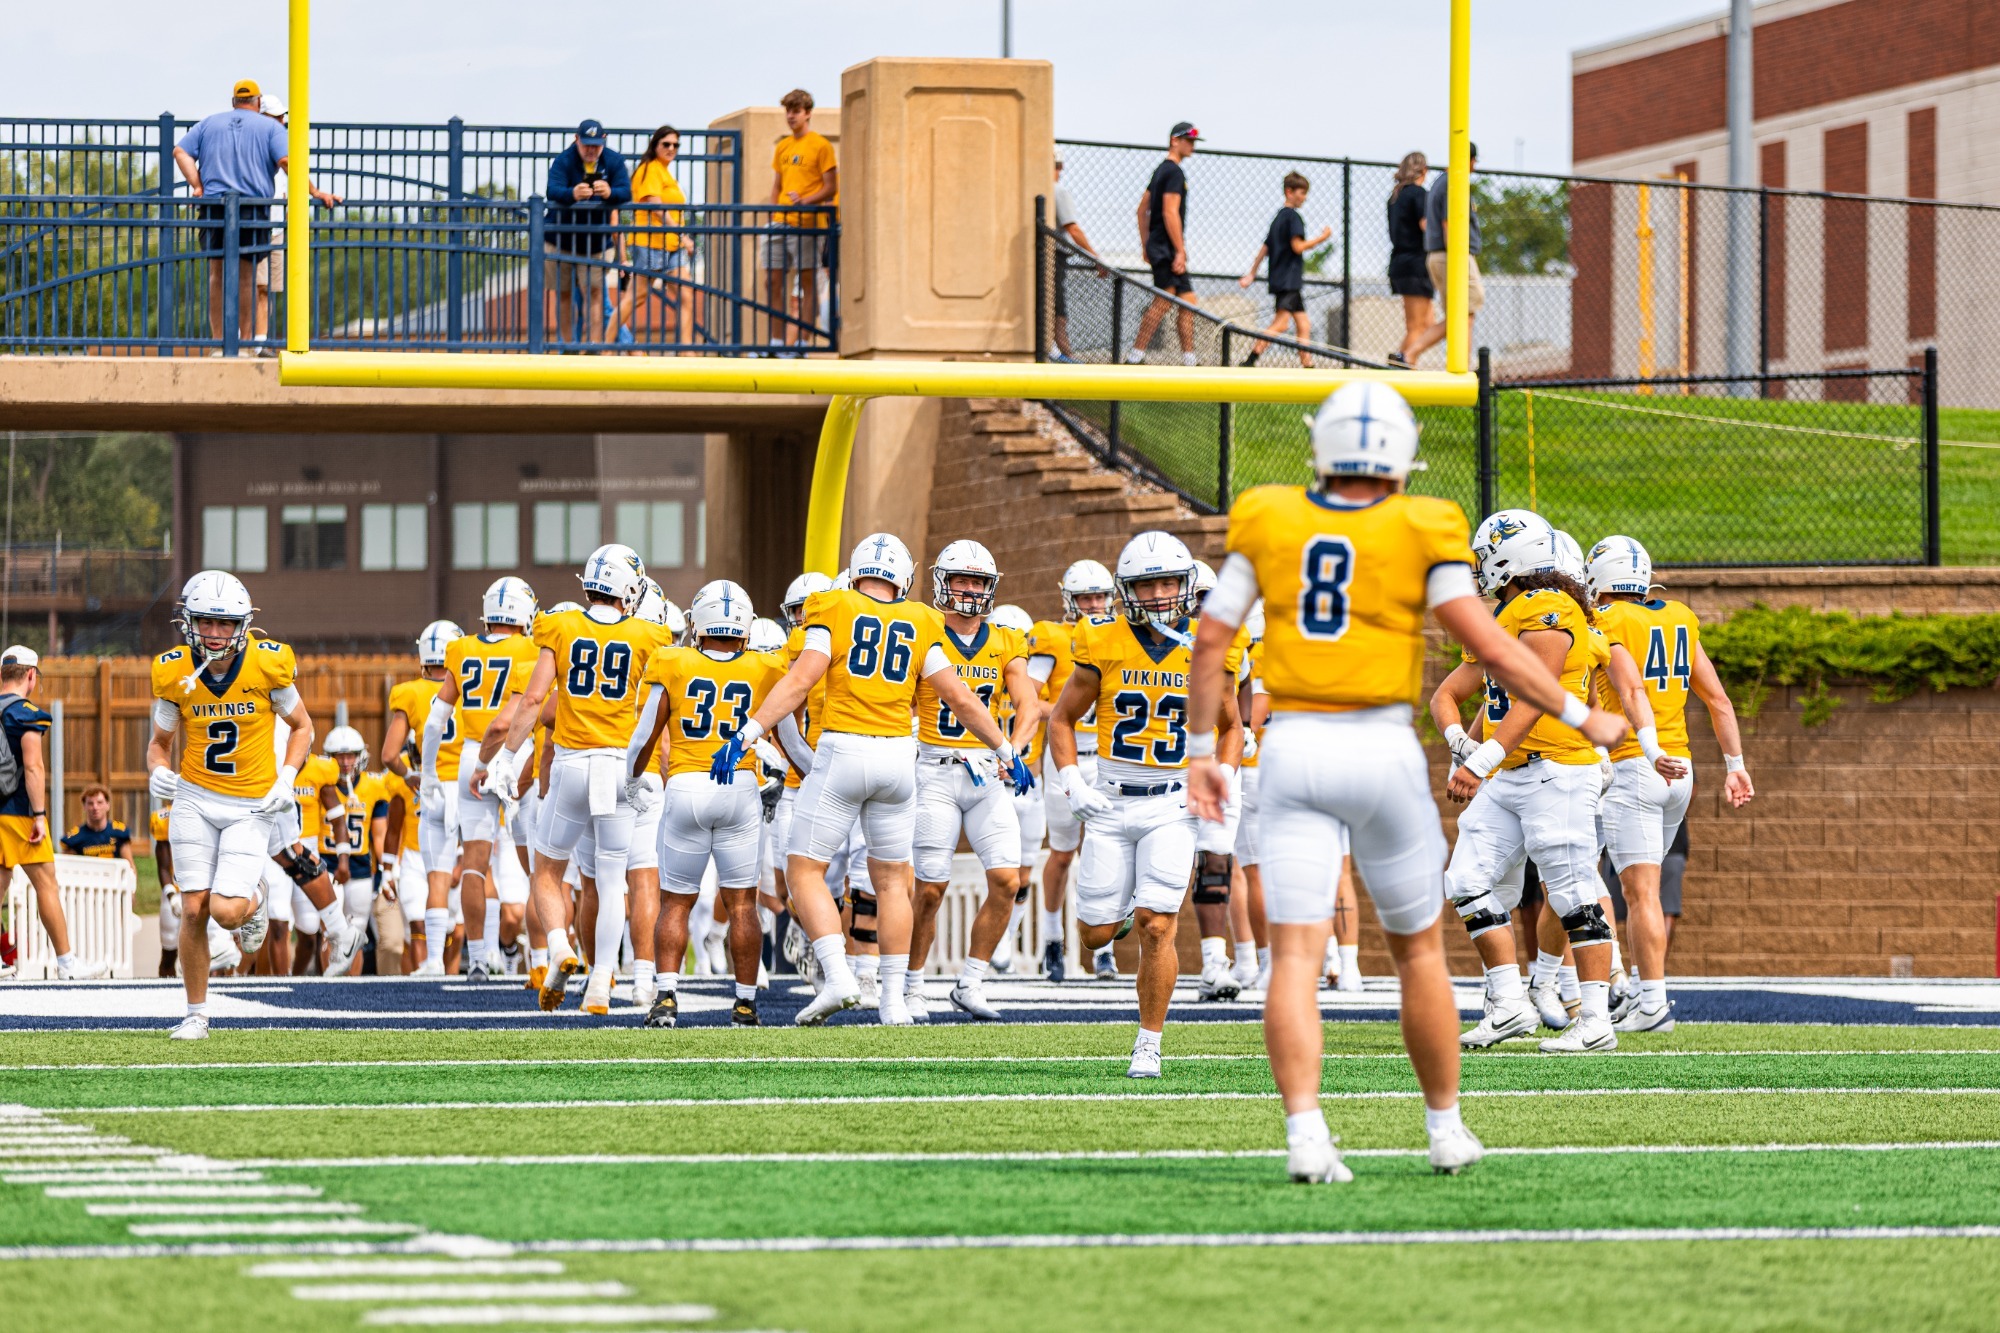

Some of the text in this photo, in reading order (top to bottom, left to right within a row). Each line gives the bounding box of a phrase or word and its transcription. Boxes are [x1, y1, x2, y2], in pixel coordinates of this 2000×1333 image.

[599, 584, 613, 594] ON!
[858, 567, 896, 580] FIGHT ON!
[1297, 533, 1356, 642] 8
[1611, 583, 1638, 592] FIGHT
[706, 626, 744, 636] FIGHT ON!
[846, 613, 916, 684] 86
[461, 657, 513, 710] 27
[566, 637, 632, 700] 89
[952, 664, 998, 680] KINGS
[1644, 625, 1692, 692] 44
[191, 701, 255, 717] VIKINGS
[679, 676, 753, 740] 33
[1111, 690, 1189, 766] 23
[205, 719, 239, 775] 2
